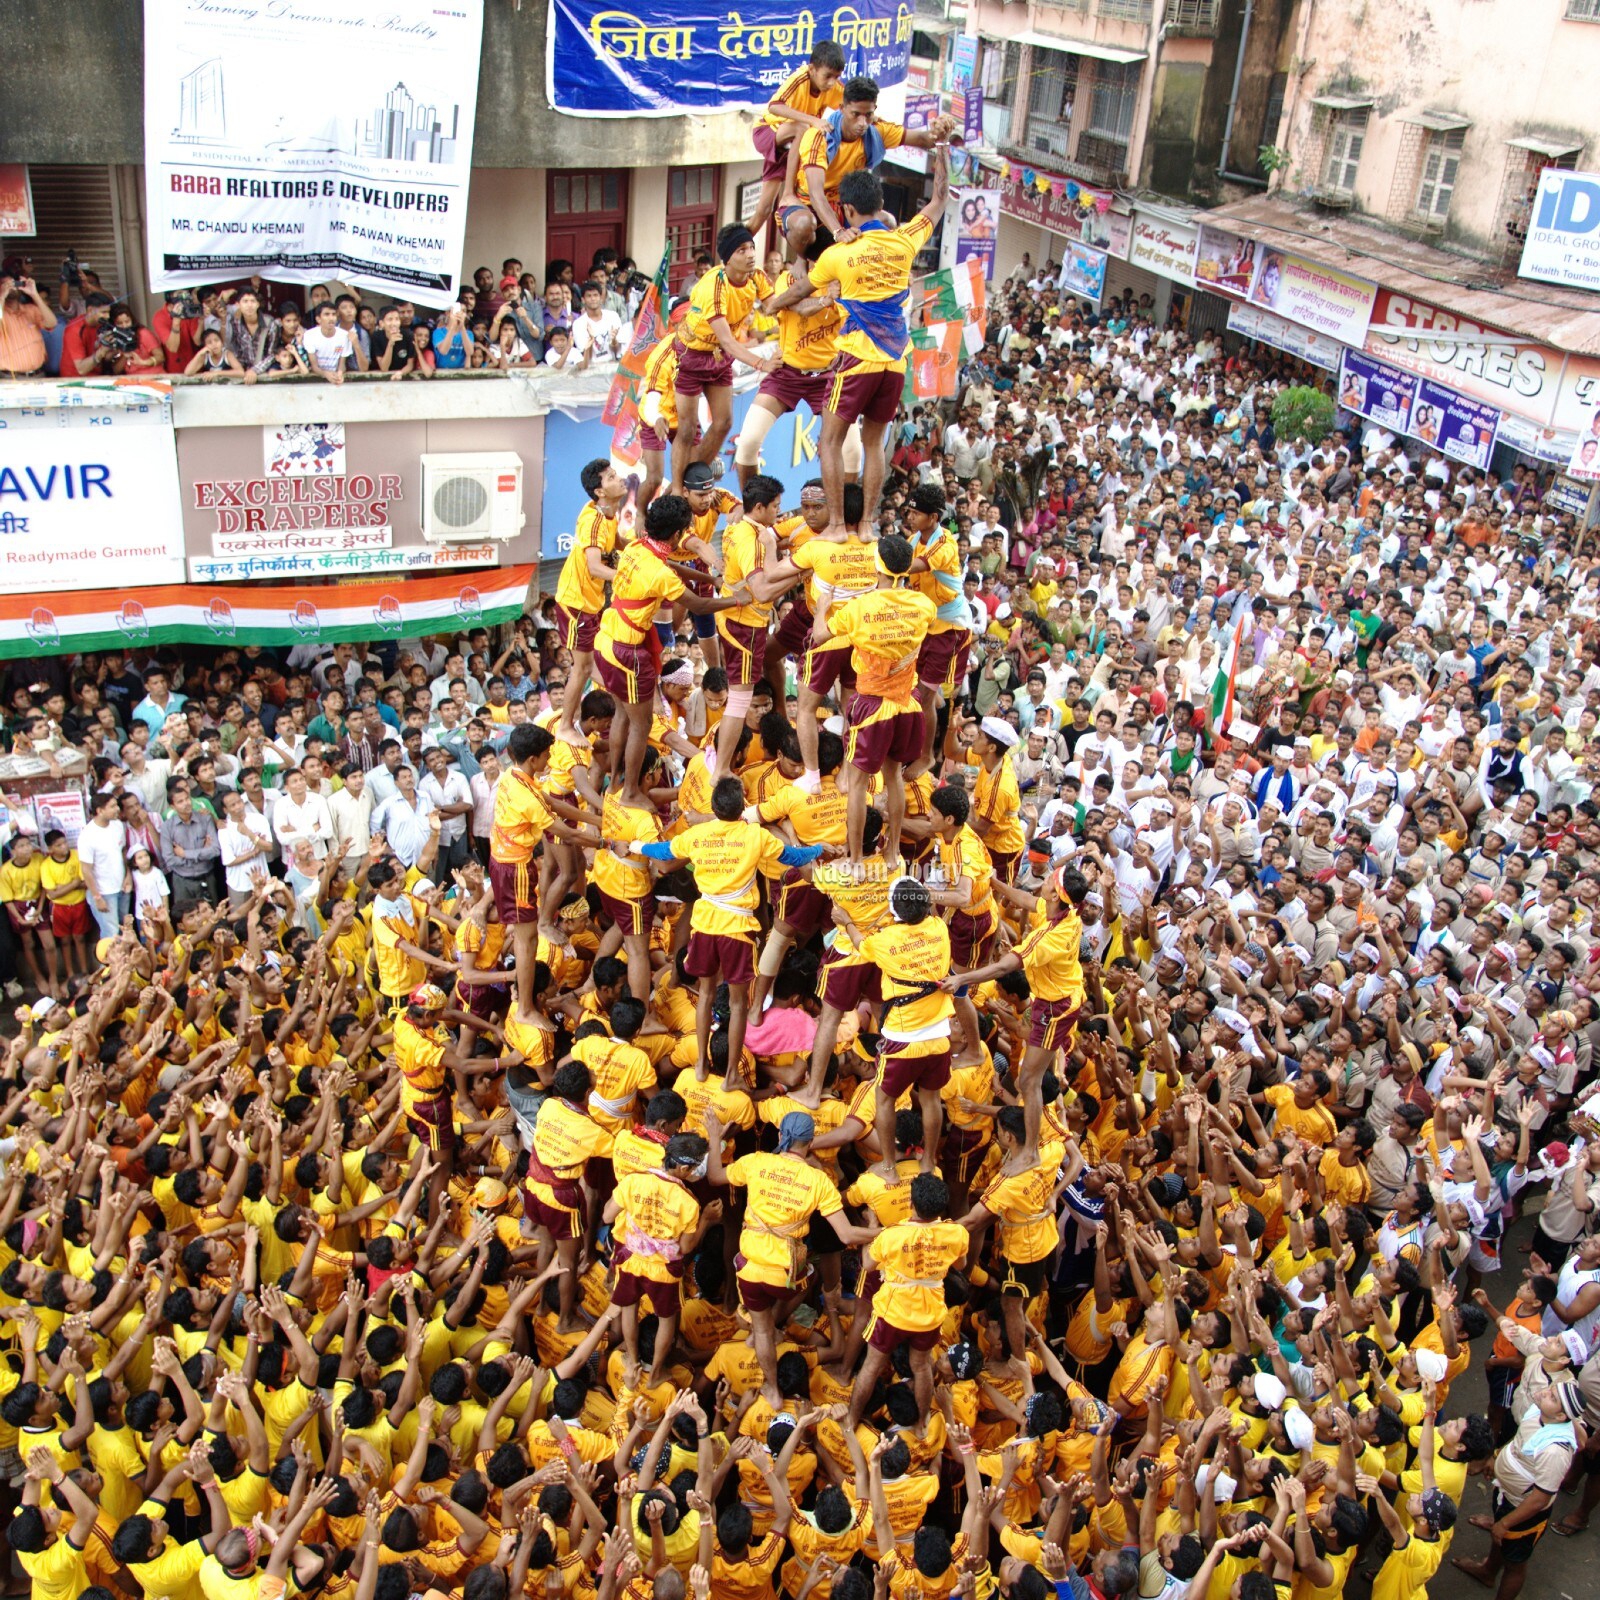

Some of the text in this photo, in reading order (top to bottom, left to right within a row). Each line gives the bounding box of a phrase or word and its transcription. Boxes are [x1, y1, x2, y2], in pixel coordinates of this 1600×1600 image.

[265, 0, 333, 23] Dreams
[338, 17, 366, 28] into
[373, 13, 438, 39] Reality
[587, 10, 696, 61] जिवा
[718, 10, 817, 58] देवशी
[192, 151, 252, 163] RESIDENTIAL
[264, 157, 325, 167] CMERCIAL
[338, 161, 390, 174] TOWNSPS
[227, 178, 318, 198] REALTORS
[323, 180, 335, 196] &
[340, 181, 449, 213] DEVELOPERS
[172, 218, 305, 234] MR. CHANDU KHEMANI
[1016, 206, 1042, 223] VASTU
[329, 220, 446, 251] MR. PAWAN KHEMANI
[1533, 231, 1568, 246] IDEAL
[1531, 263, 1600, 284] Health Tourism
[1563, 253, 1573, 263] IT
[1372, 342, 1464, 388] GAMES & TOYS
[0, 464, 113, 502] AVIR
[193, 474, 404, 509] EXCELSIOR
[216, 501, 391, 534] DRAPERS
[6, 544, 168, 565] Readymade Garment
[218, 532, 336, 552] एक्सेलसियर
[195, 561, 234, 580] स्कुल
[406, 553, 433, 567] आणि
[434, 545, 496, 565] होजीयरी
